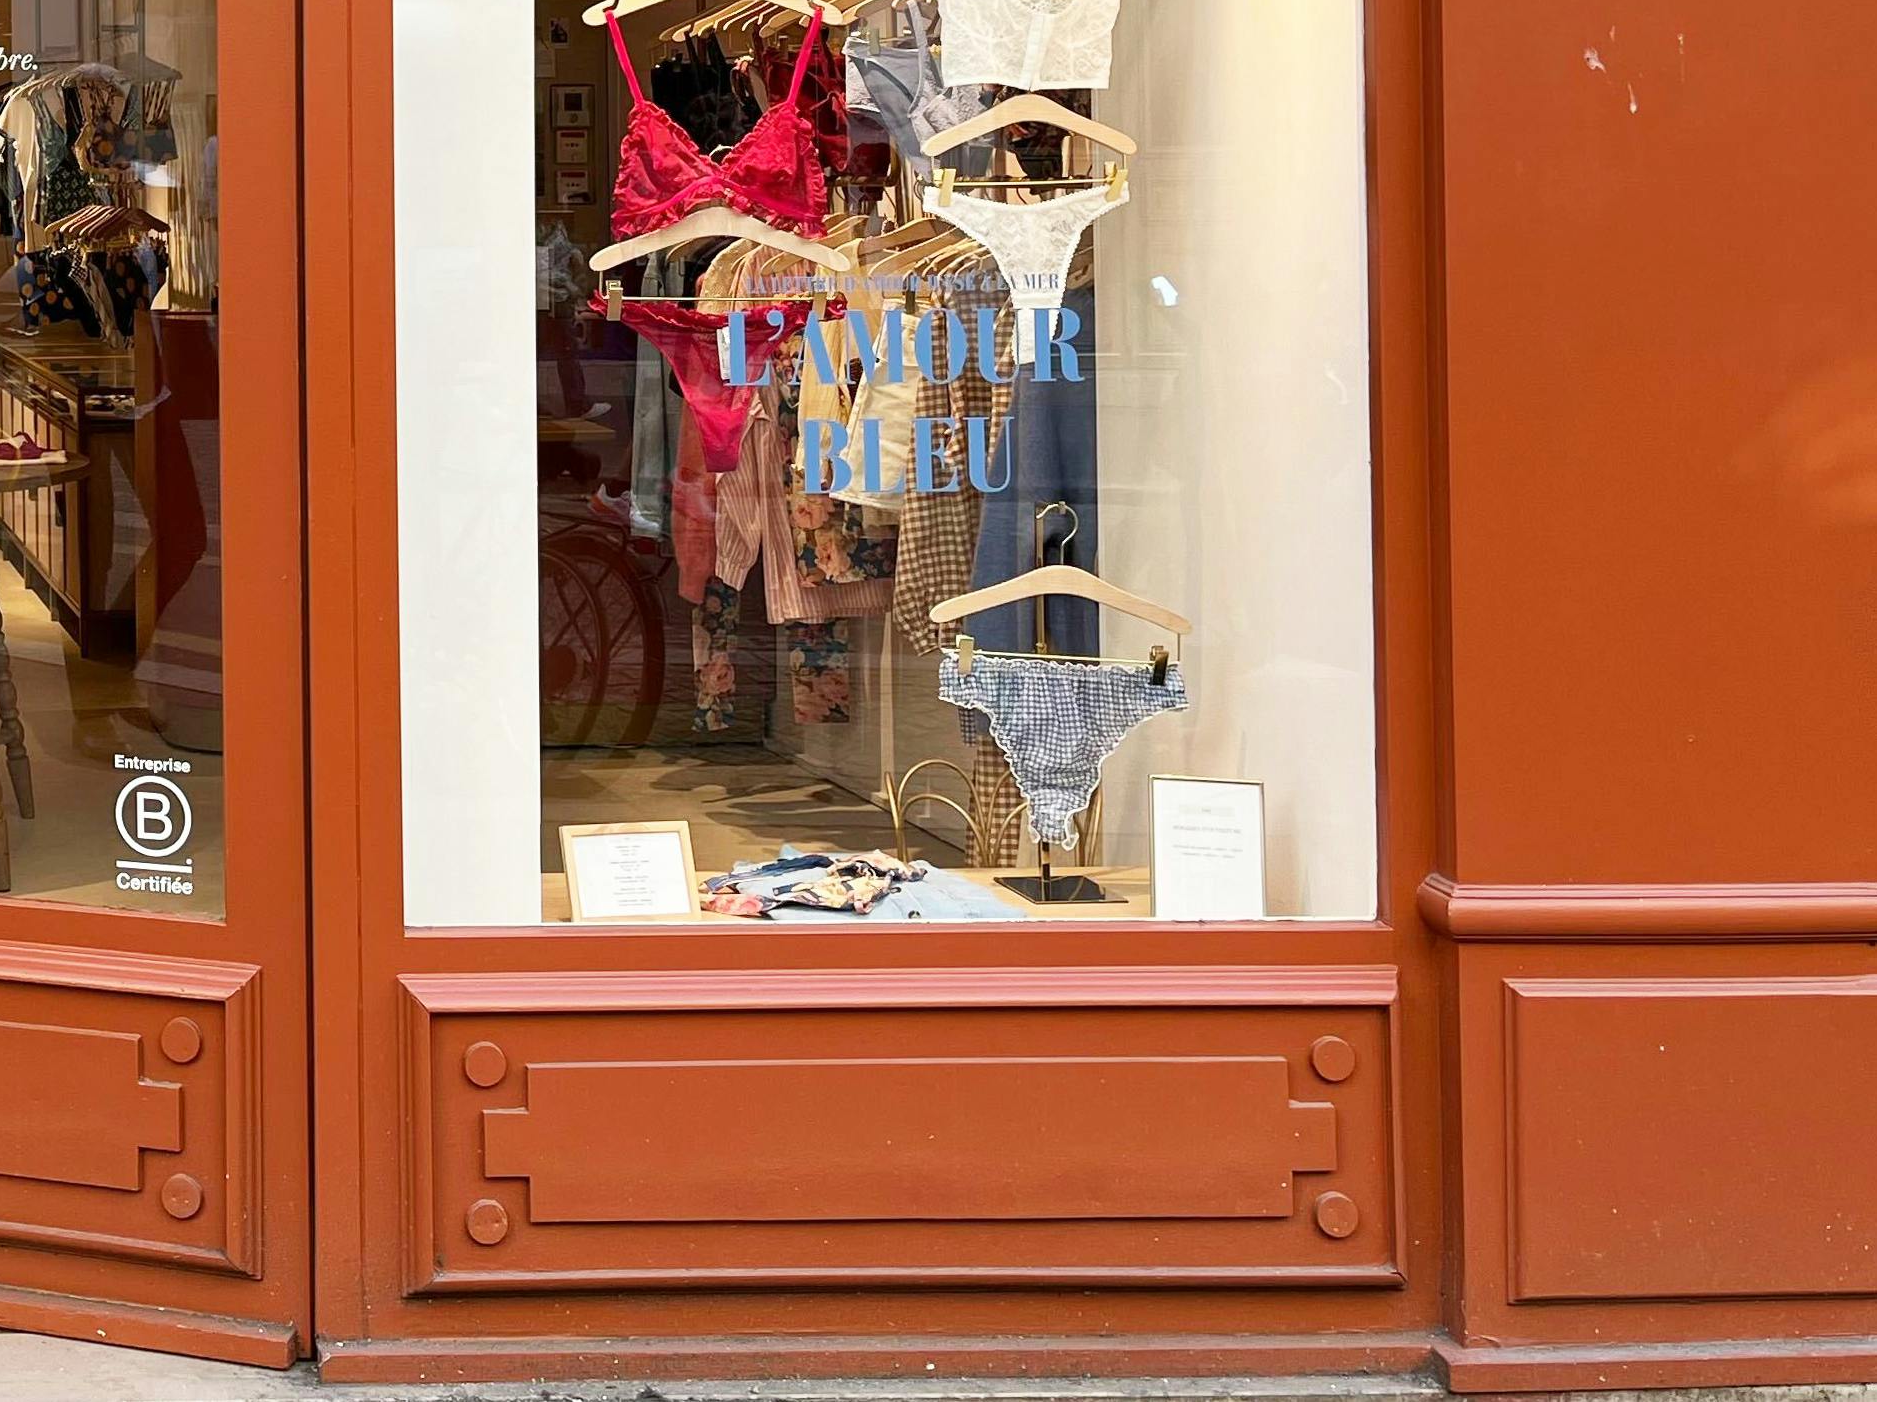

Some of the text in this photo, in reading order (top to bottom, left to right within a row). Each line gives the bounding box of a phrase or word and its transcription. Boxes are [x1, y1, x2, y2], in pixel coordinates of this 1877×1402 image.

[1024, 273, 1059, 290] MER
[723, 307, 1085, 386] L'AMOUR
[803, 416, 1014, 494] BLEU
[114, 754, 191, 773] Entreprise
[136, 791, 173, 841] B
[116, 872, 193, 895] Certifiée
